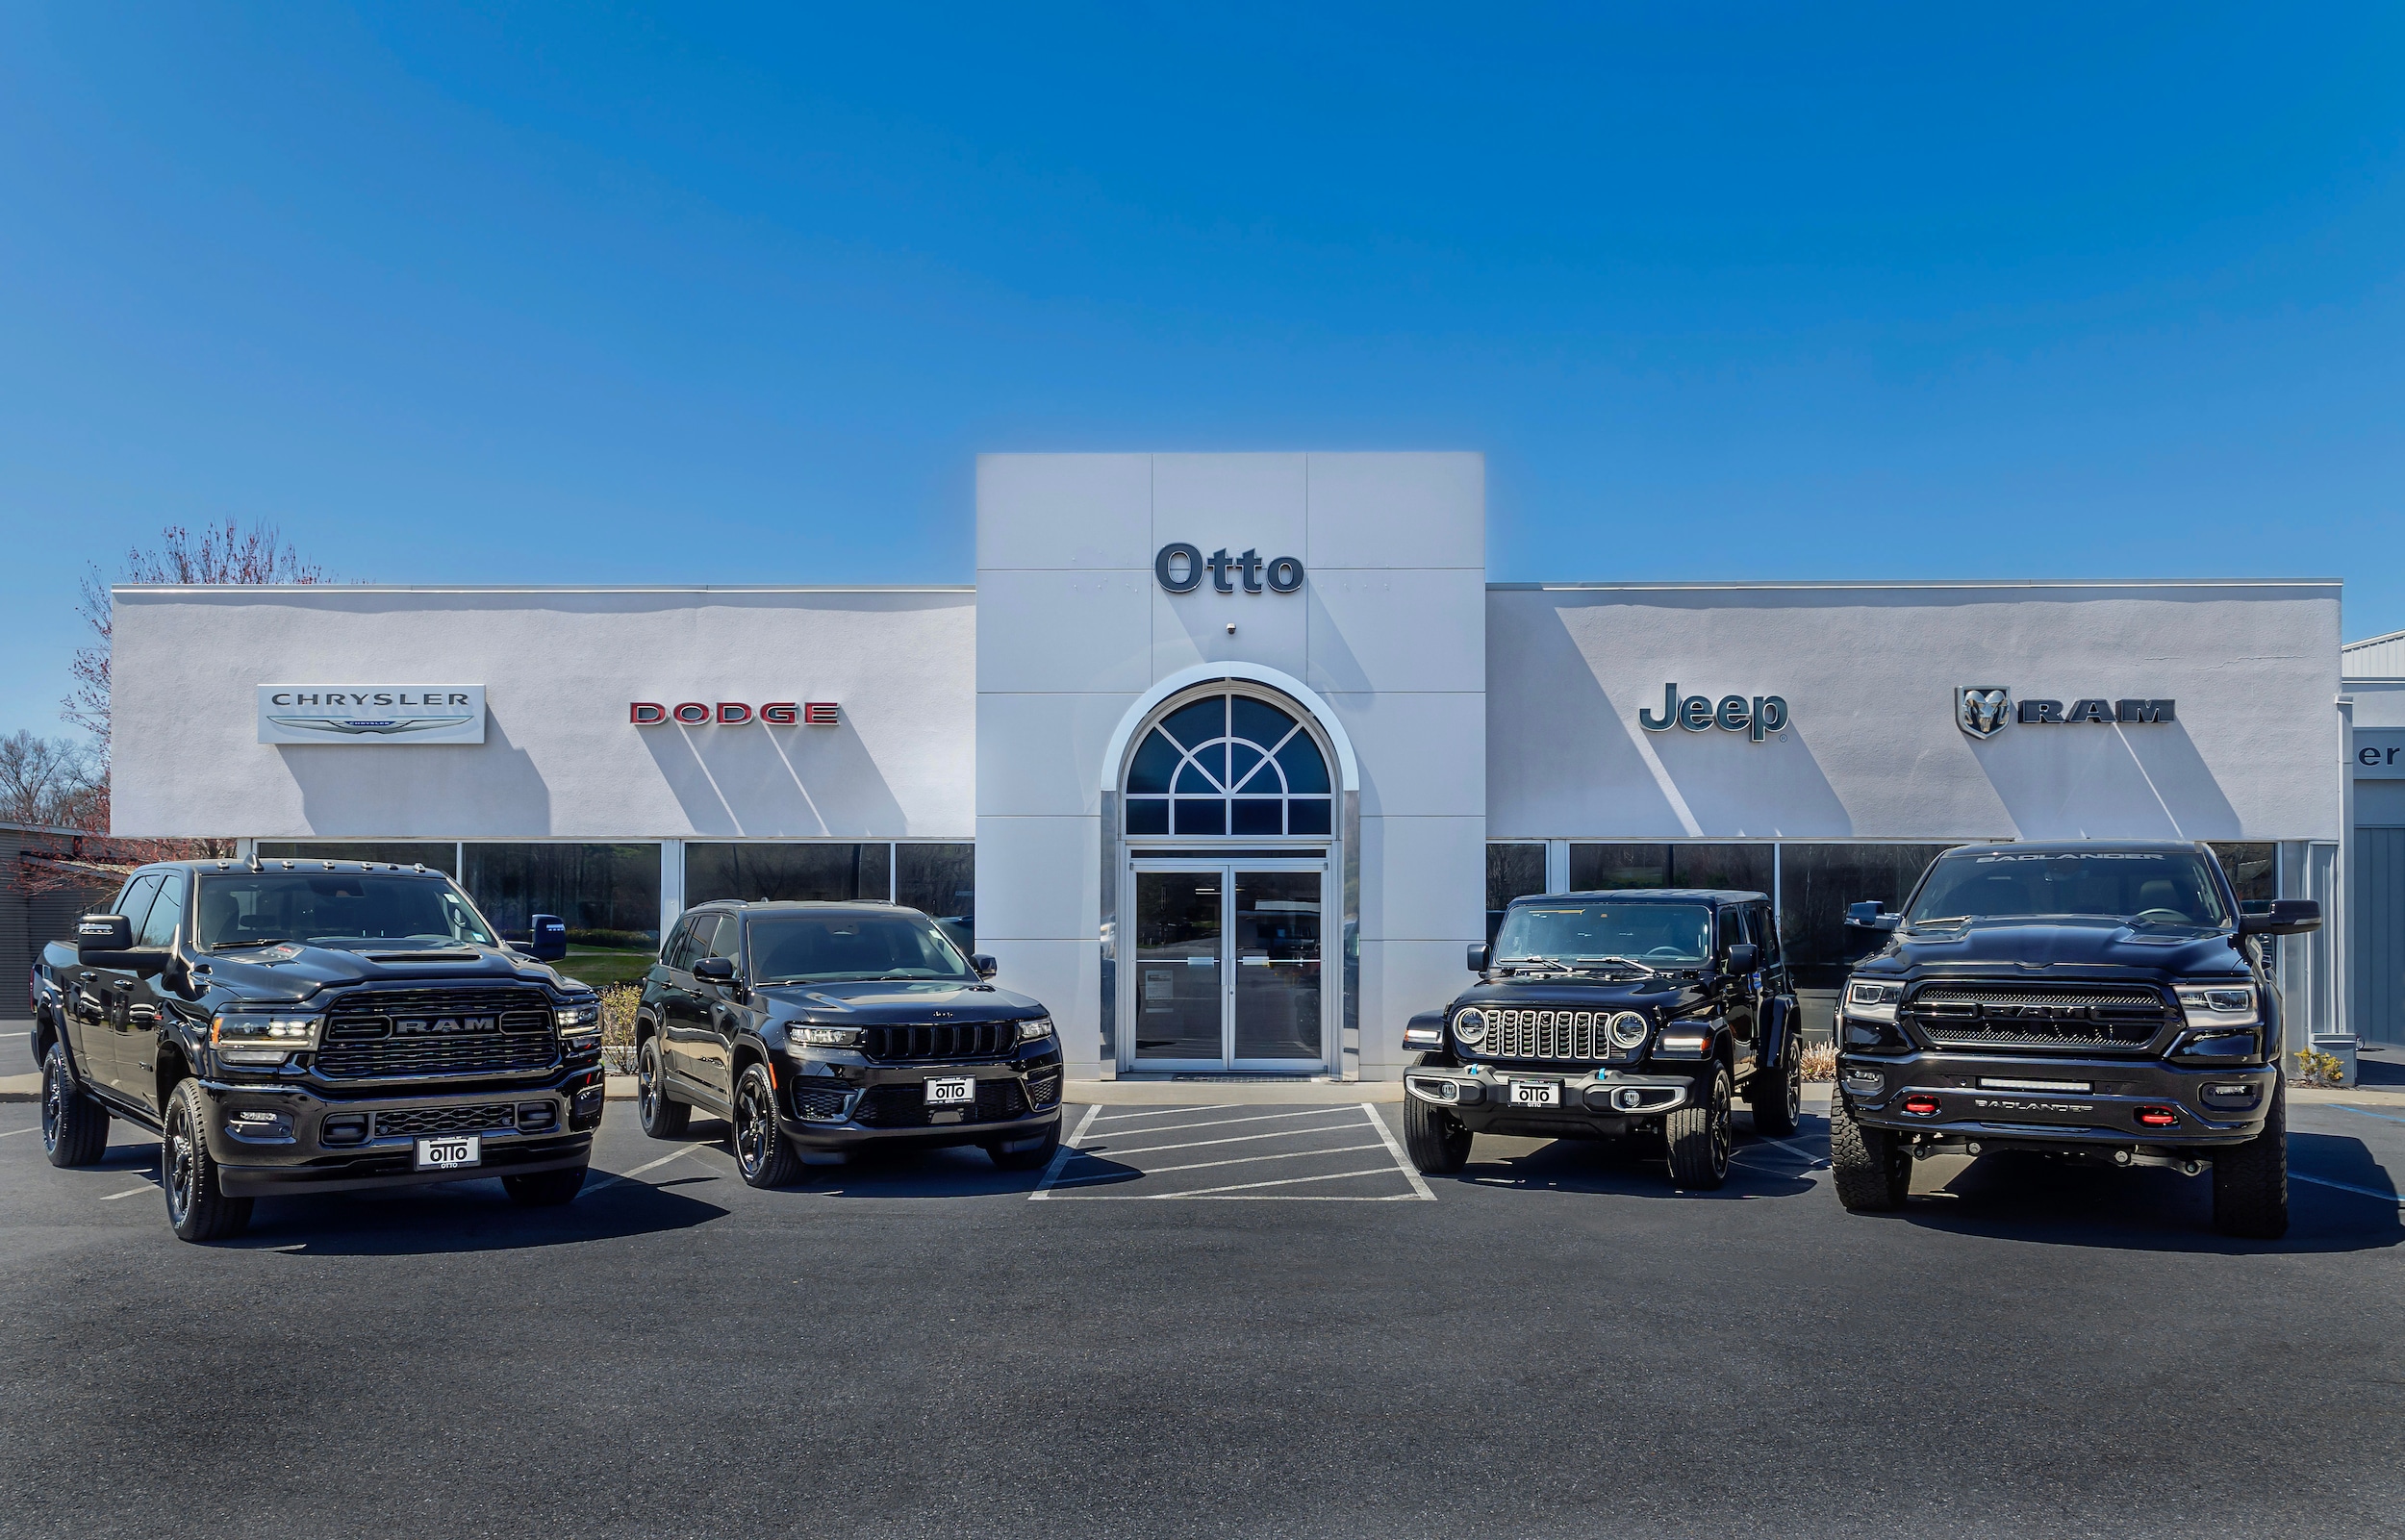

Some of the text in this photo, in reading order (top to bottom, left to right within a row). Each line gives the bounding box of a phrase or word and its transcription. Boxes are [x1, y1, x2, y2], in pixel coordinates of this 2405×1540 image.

[1155, 542, 1304, 593] Otto
[271, 694, 469, 706] CHRYSLER
[2017, 698, 2176, 723] RAM
[629, 702, 840, 725] DODGE
[1638, 682, 1789, 743] Jeep
[1976, 853, 2165, 864] BADLANDER
[396, 1018, 494, 1033] RAM
